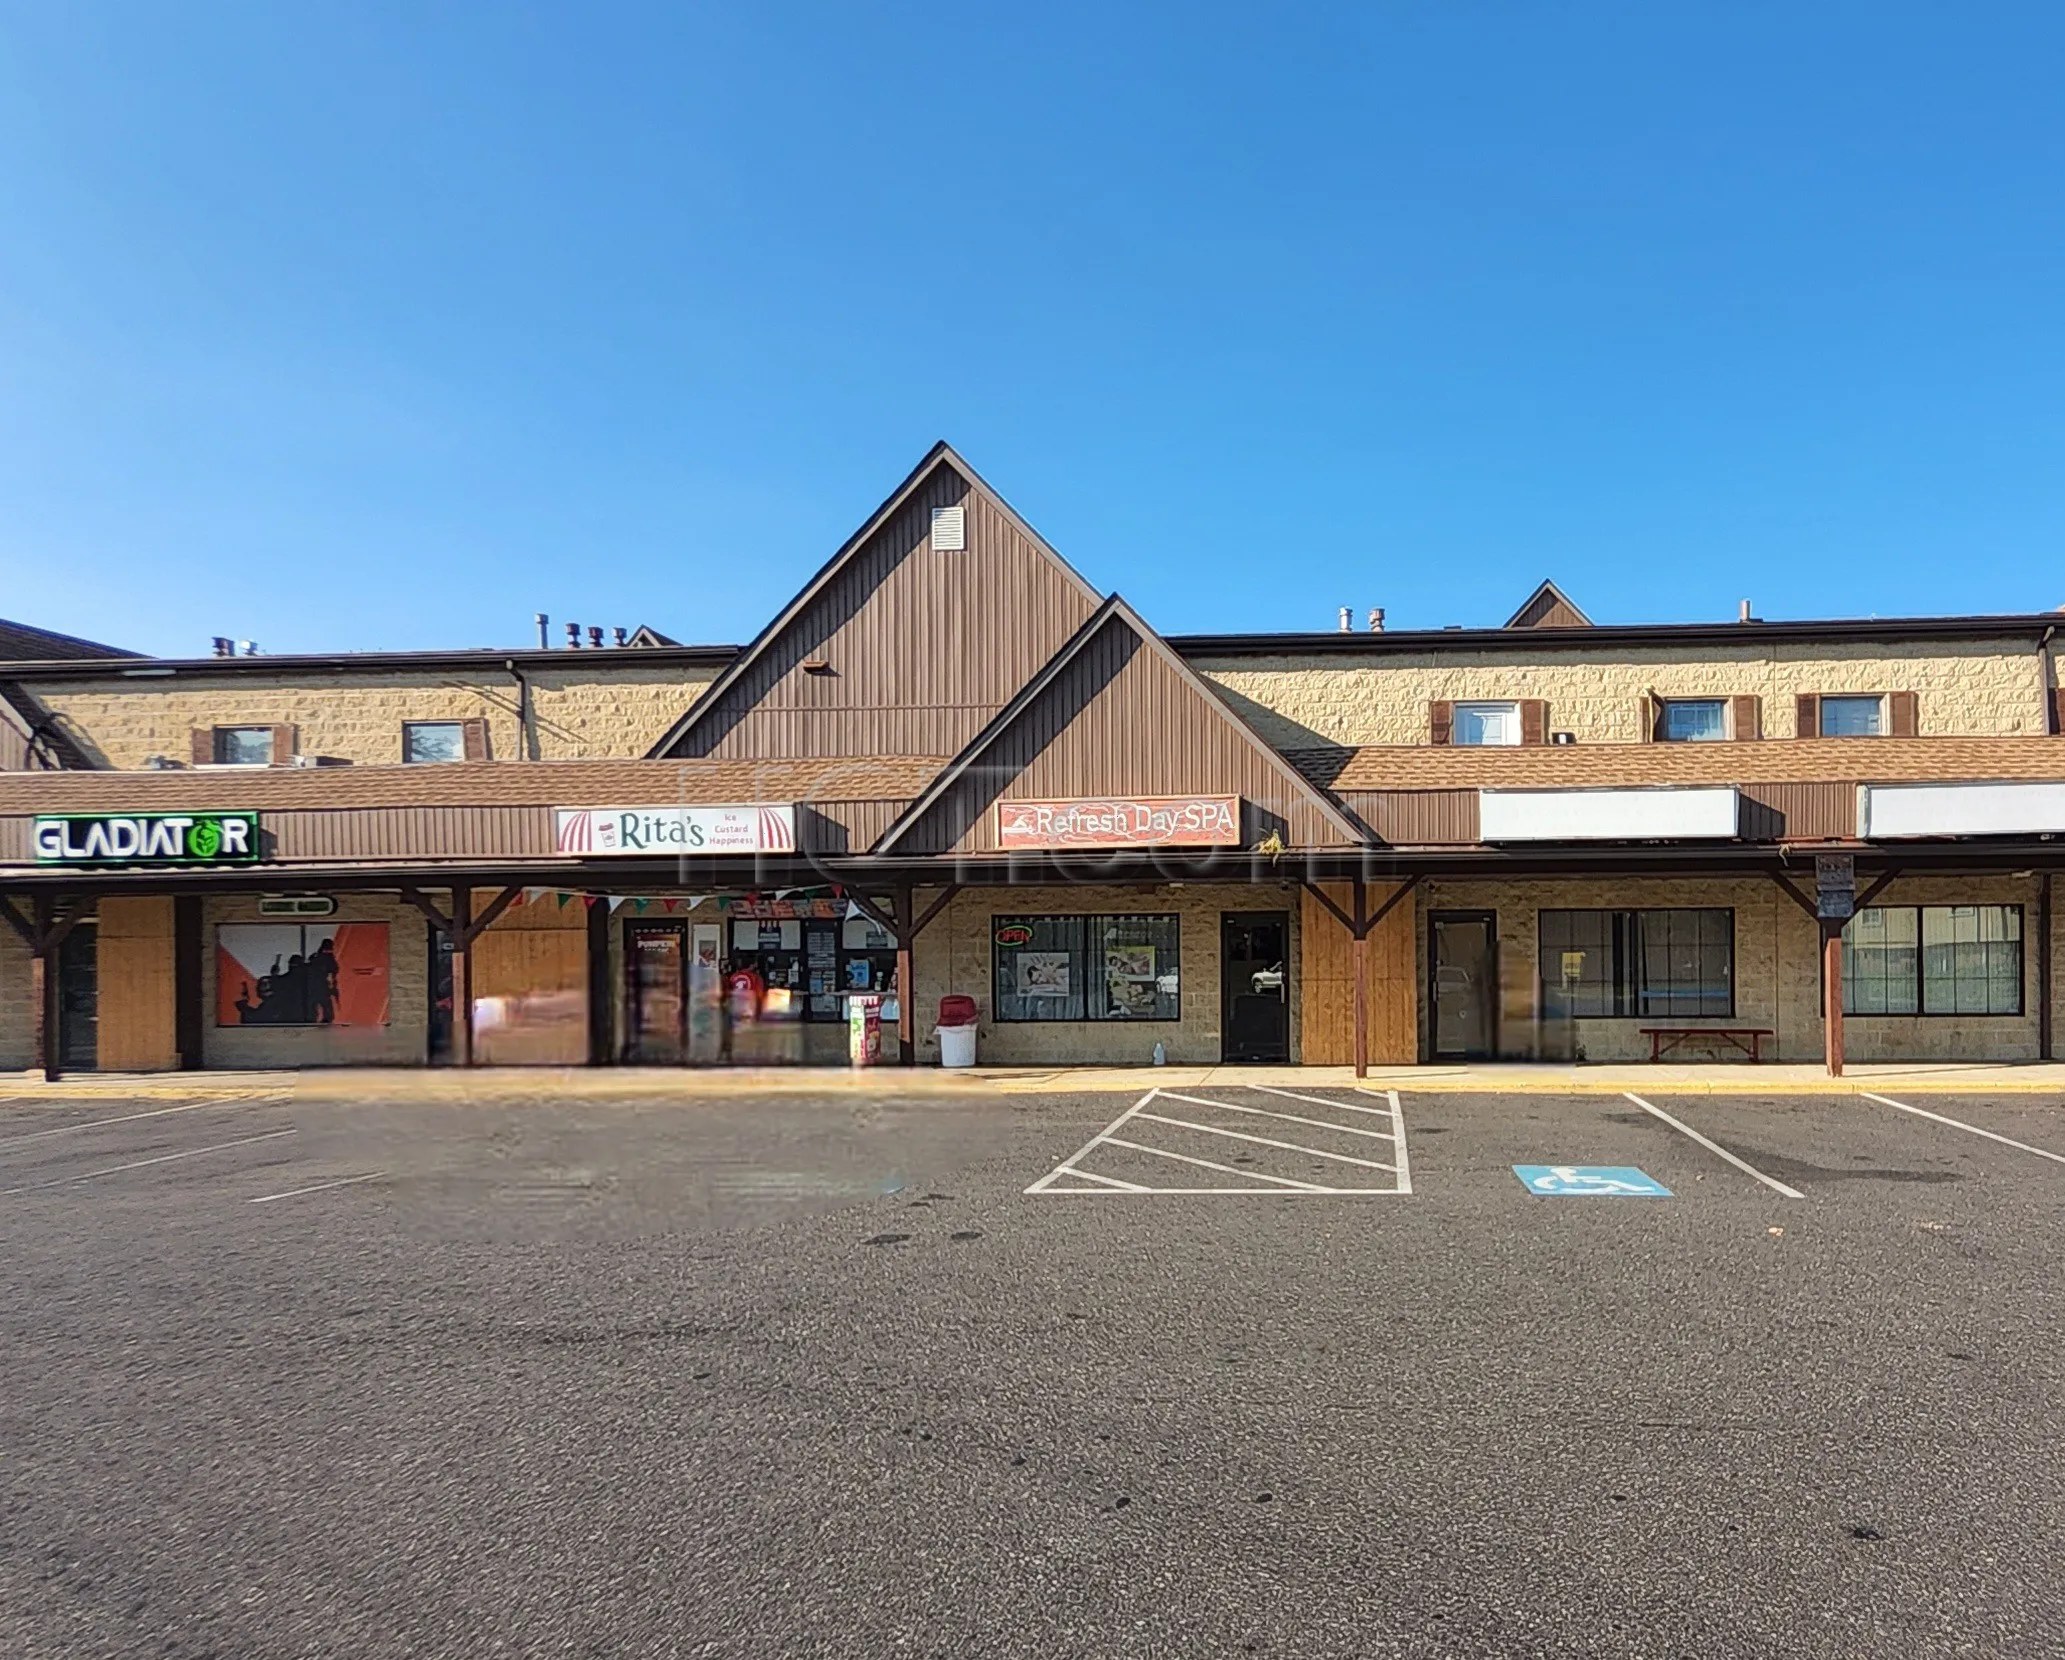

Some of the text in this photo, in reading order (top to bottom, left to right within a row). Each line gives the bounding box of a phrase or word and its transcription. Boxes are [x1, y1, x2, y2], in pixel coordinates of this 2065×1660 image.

[724, 813, 737, 822] Ice
[1036, 803, 1234, 837] Refresh Day SPA
[620, 812, 705, 850] Rita's
[714, 824, 749, 834] Custard
[709, 835, 754, 846] Happiness
[996, 929, 1030, 943] OPEN
